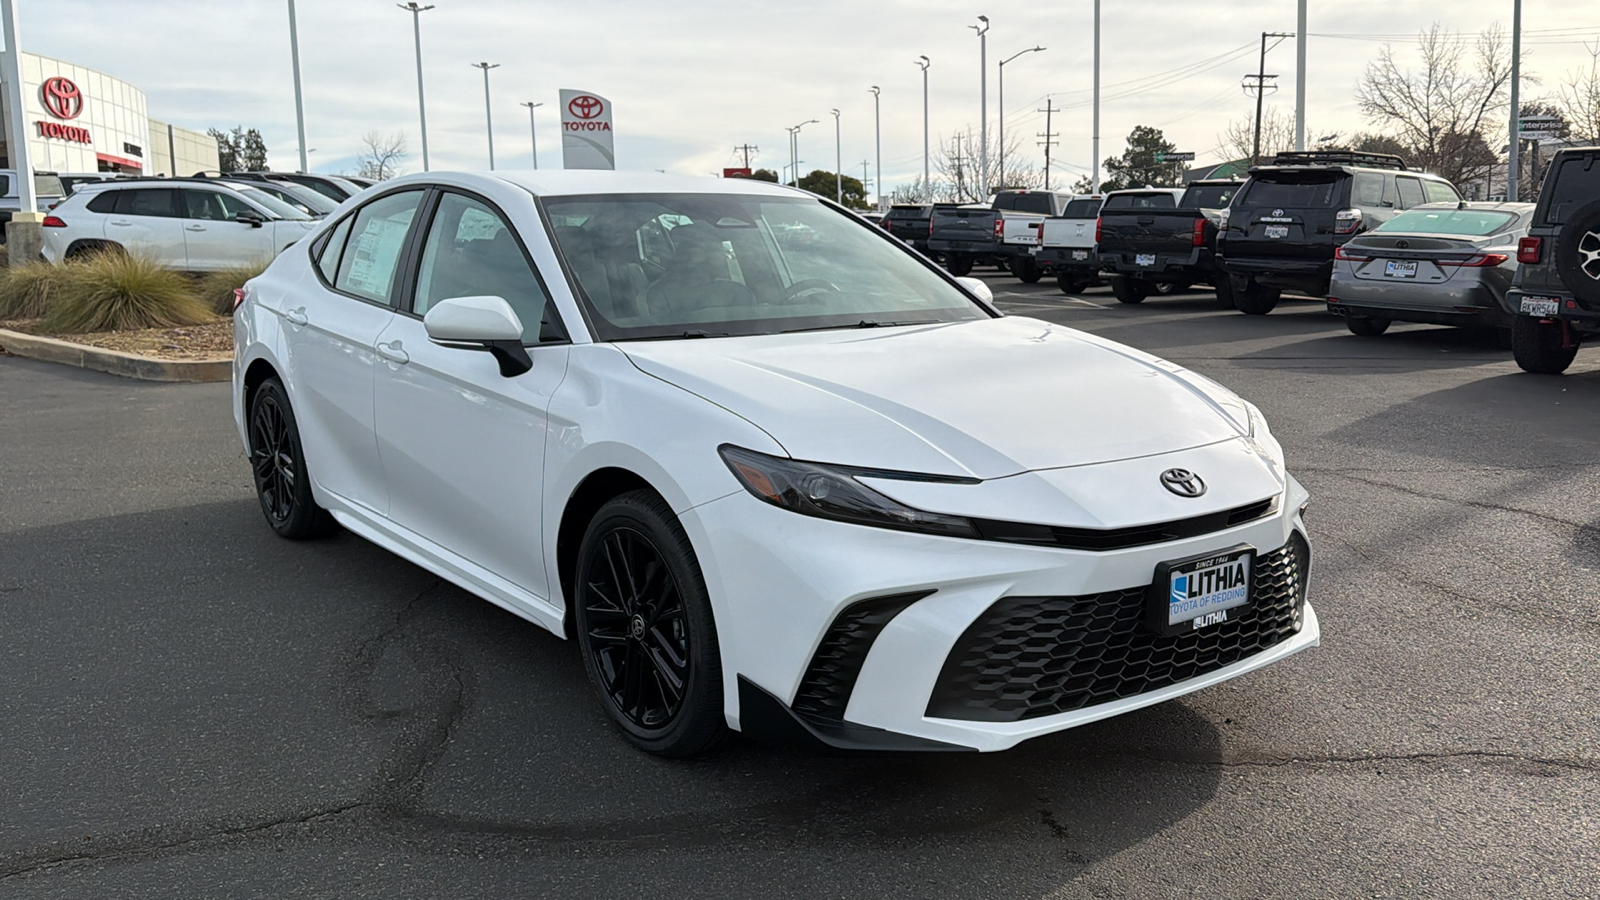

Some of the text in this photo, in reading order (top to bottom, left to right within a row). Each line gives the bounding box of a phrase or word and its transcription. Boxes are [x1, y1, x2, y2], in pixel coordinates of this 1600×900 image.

[37, 120, 92, 144] TOYOTA
[563, 121, 611, 132] TOYOTA
[1195, 559, 1214, 570] SINCE
[1187, 562, 1245, 599] LITHIA
[1170, 586, 1246, 615] TOYOTA OF REDDING
[1201, 609, 1228, 626] LITHIA
